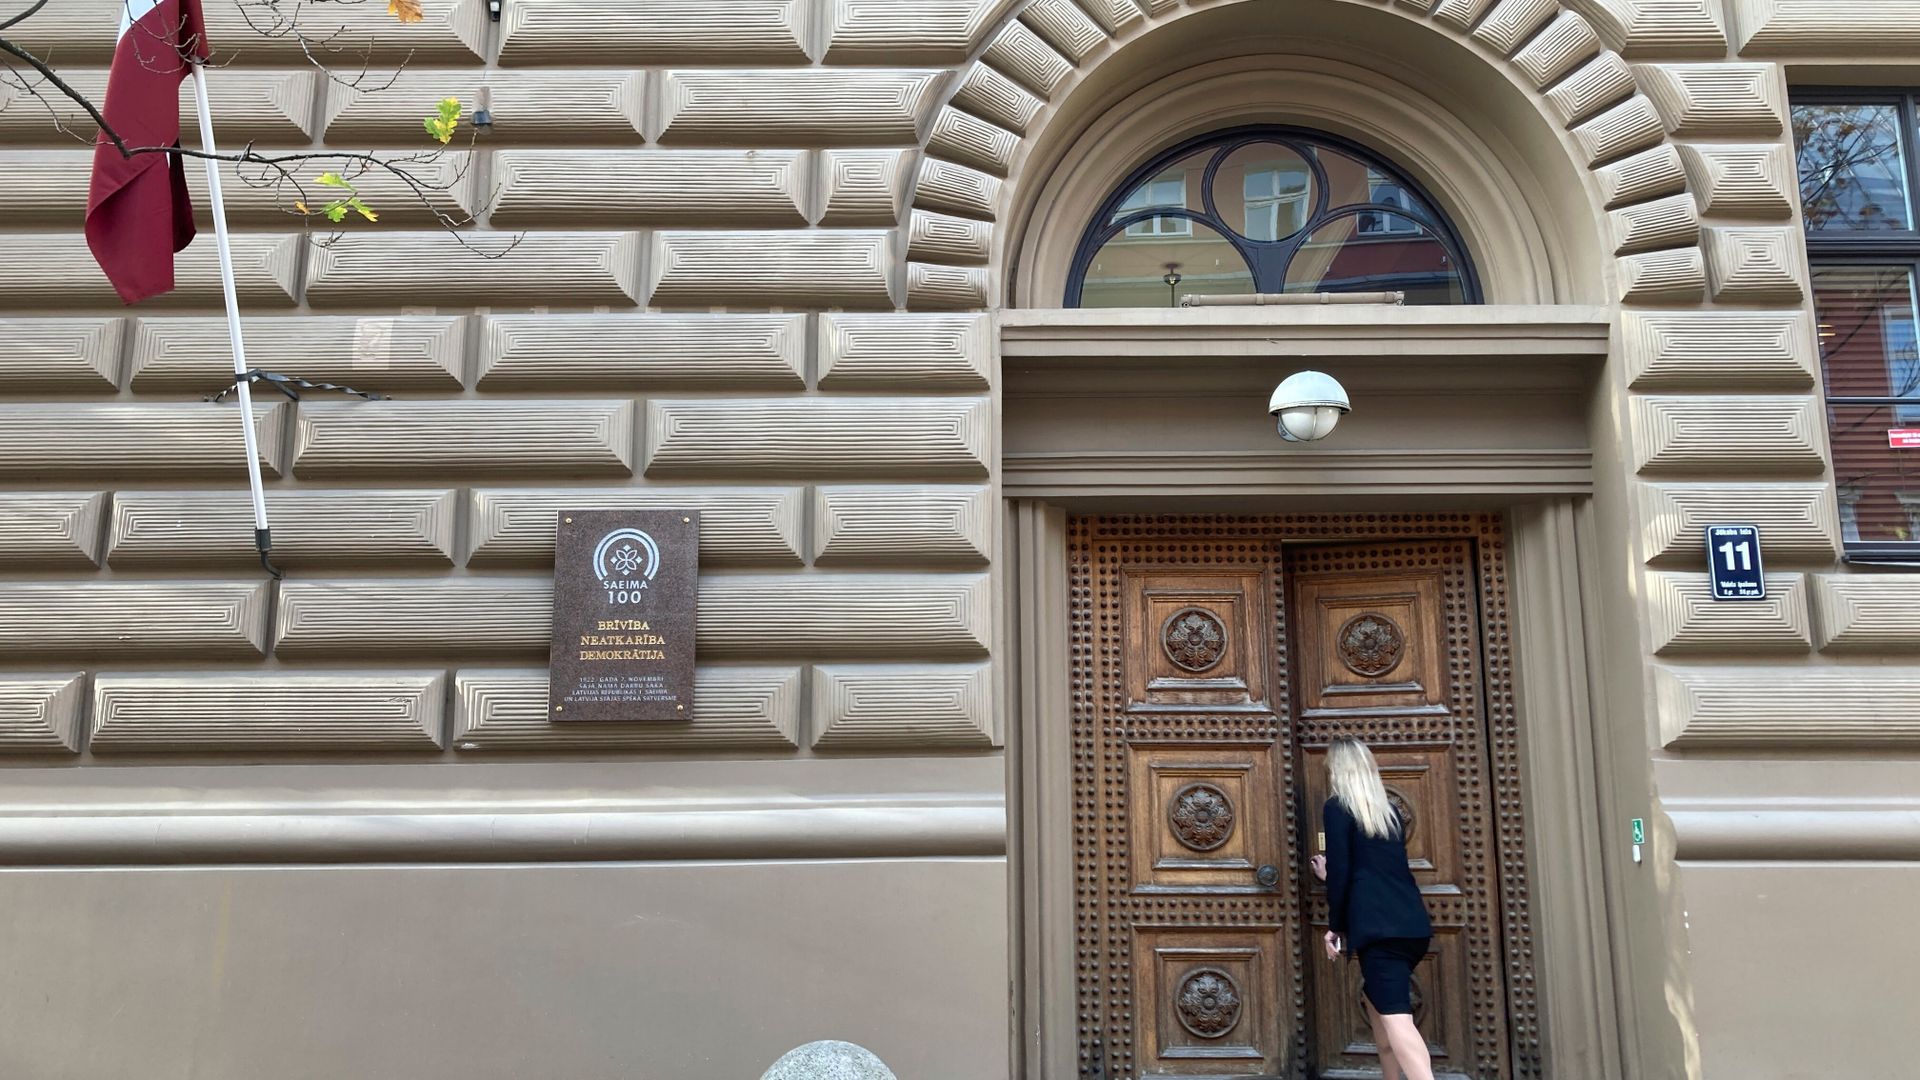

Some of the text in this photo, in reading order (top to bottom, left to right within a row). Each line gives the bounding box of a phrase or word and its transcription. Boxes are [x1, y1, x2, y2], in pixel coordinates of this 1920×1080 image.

[1719, 541, 1751, 571] 11
[603, 580, 648, 589] SAEIMA
[608, 591, 642, 604] 100
[597, 619, 650, 630] BRĪVĪBA
[580, 634, 666, 645] NEATKARĪBA
[579, 649, 665, 660] DEMOKRĀTIJA
